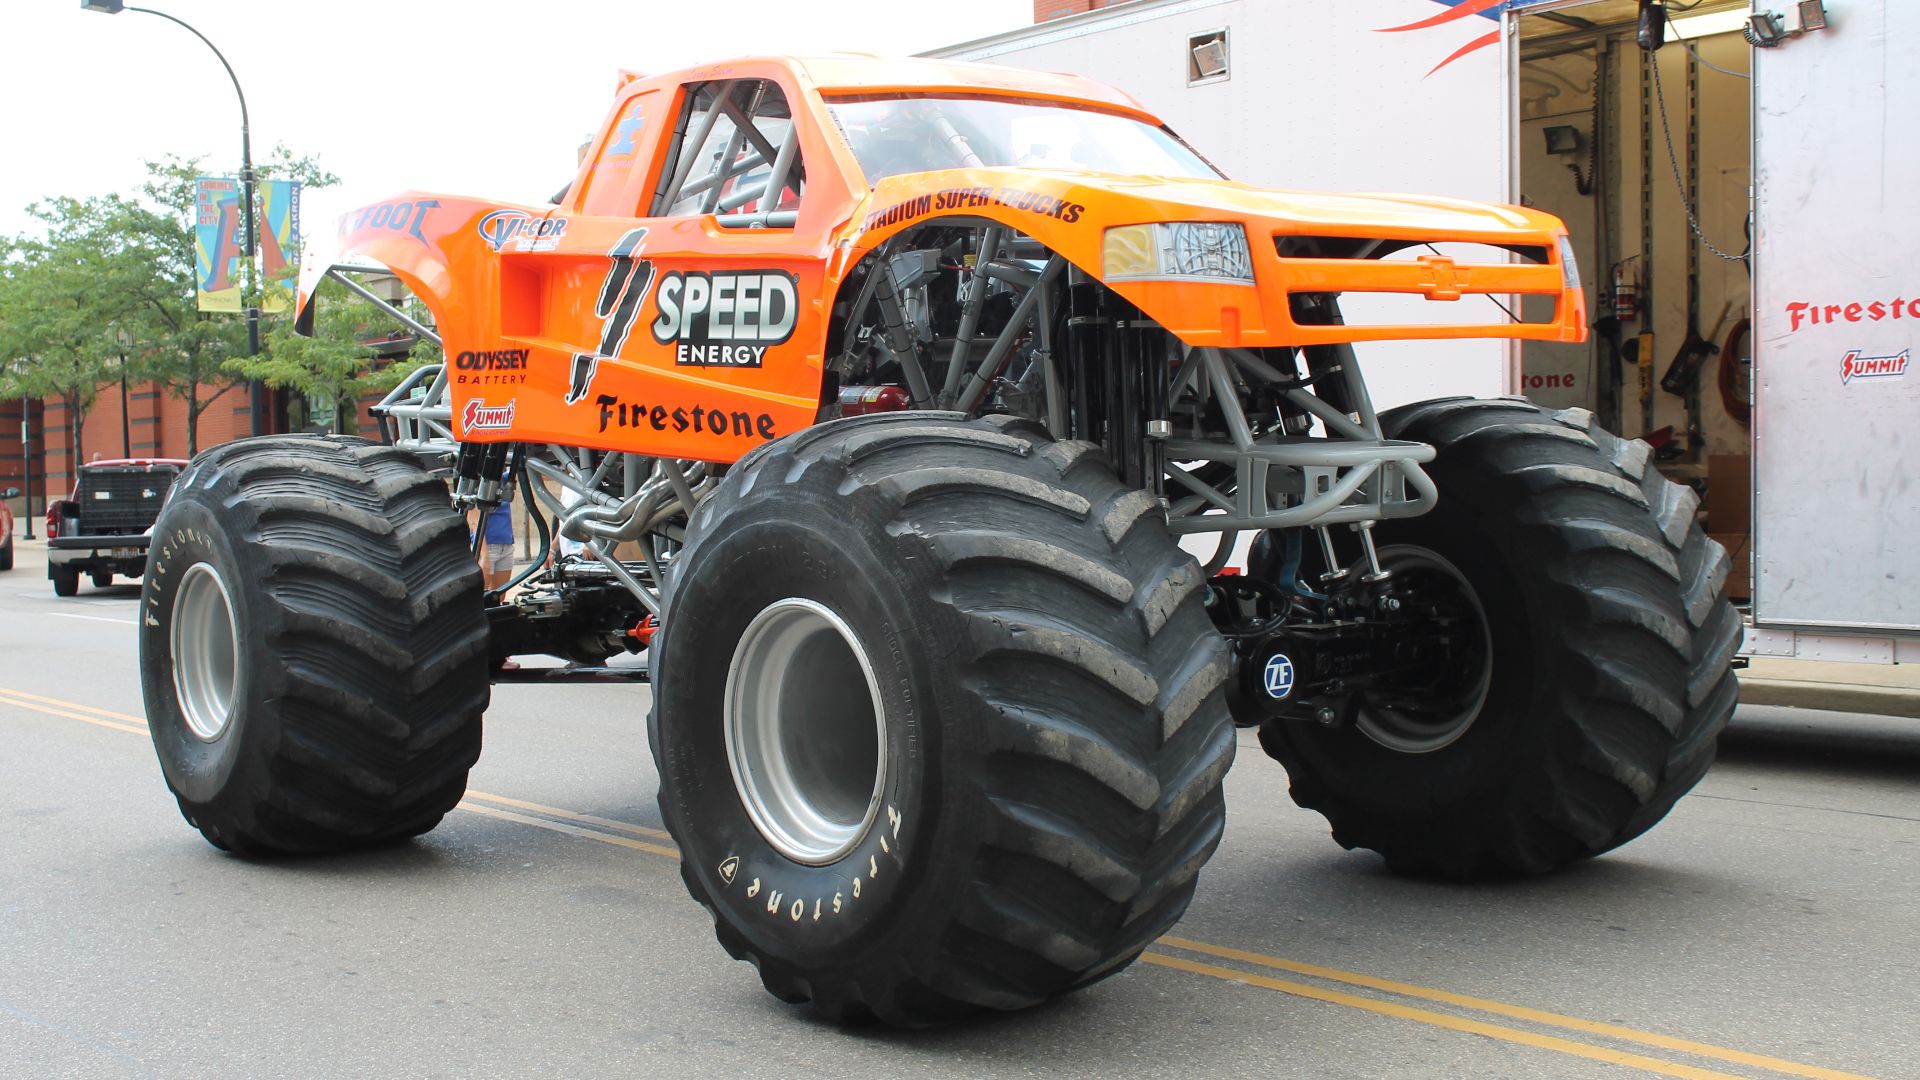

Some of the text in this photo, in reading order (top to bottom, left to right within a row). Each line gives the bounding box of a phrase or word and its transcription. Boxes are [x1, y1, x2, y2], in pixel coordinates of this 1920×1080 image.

[200, 216, 219, 225] CITY
[291, 187, 299, 230] AKRON
[338, 200, 441, 248] FOOT
[860, 187, 1085, 234] STADIUM SUPER TRUCKS
[496, 216, 567, 252] VI-COR
[653, 272, 798, 342] SPEED
[456, 349, 530, 370] ODYSSEY
[677, 344, 766, 365] ENERGY
[457, 375, 527, 384] BATTERY
[596, 394, 776, 439] Firestone
[1266, 663, 1291, 690] ZF
[748, 804, 902, 922] Firestone
